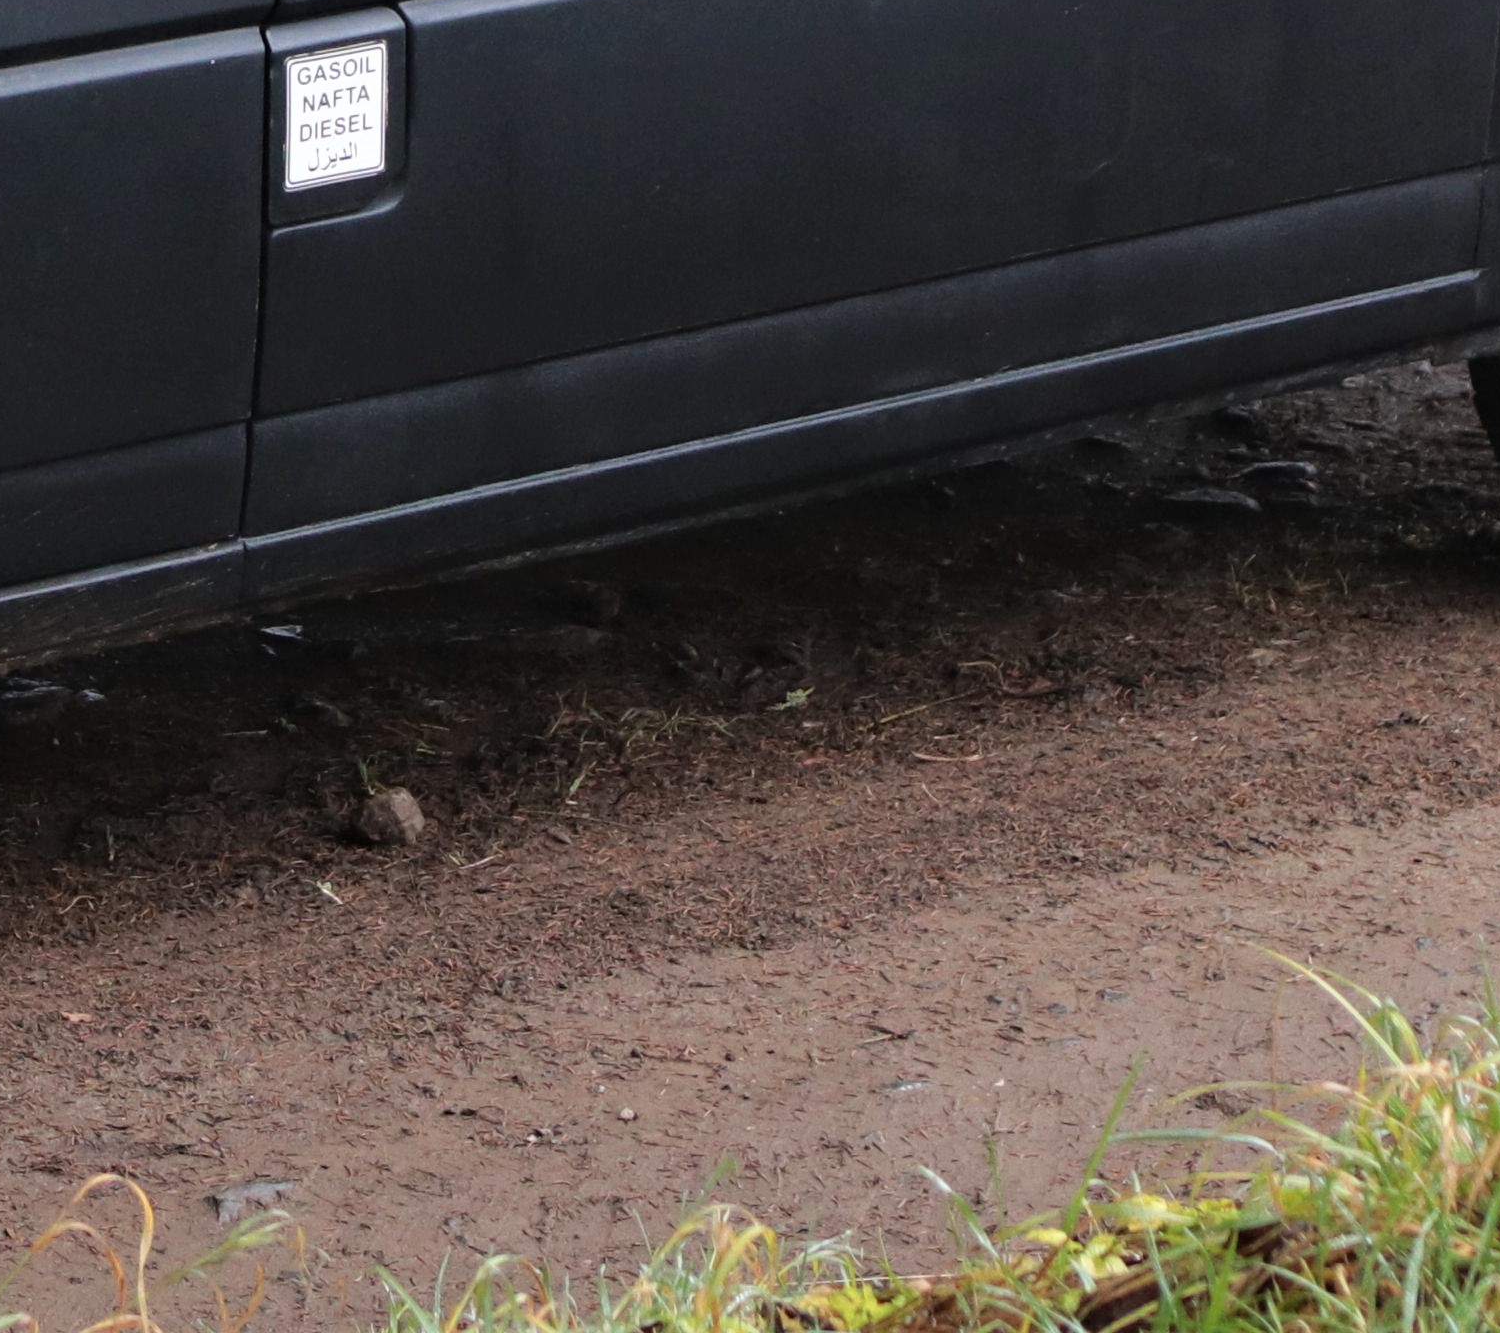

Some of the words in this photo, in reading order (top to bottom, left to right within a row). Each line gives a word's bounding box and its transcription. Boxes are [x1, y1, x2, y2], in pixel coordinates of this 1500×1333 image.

[297, 56, 376, 85] GASOIL
[303, 85, 370, 113] NAFTA
[300, 113, 373, 143] DIESEL
[308, 142, 358, 172] الديزل
